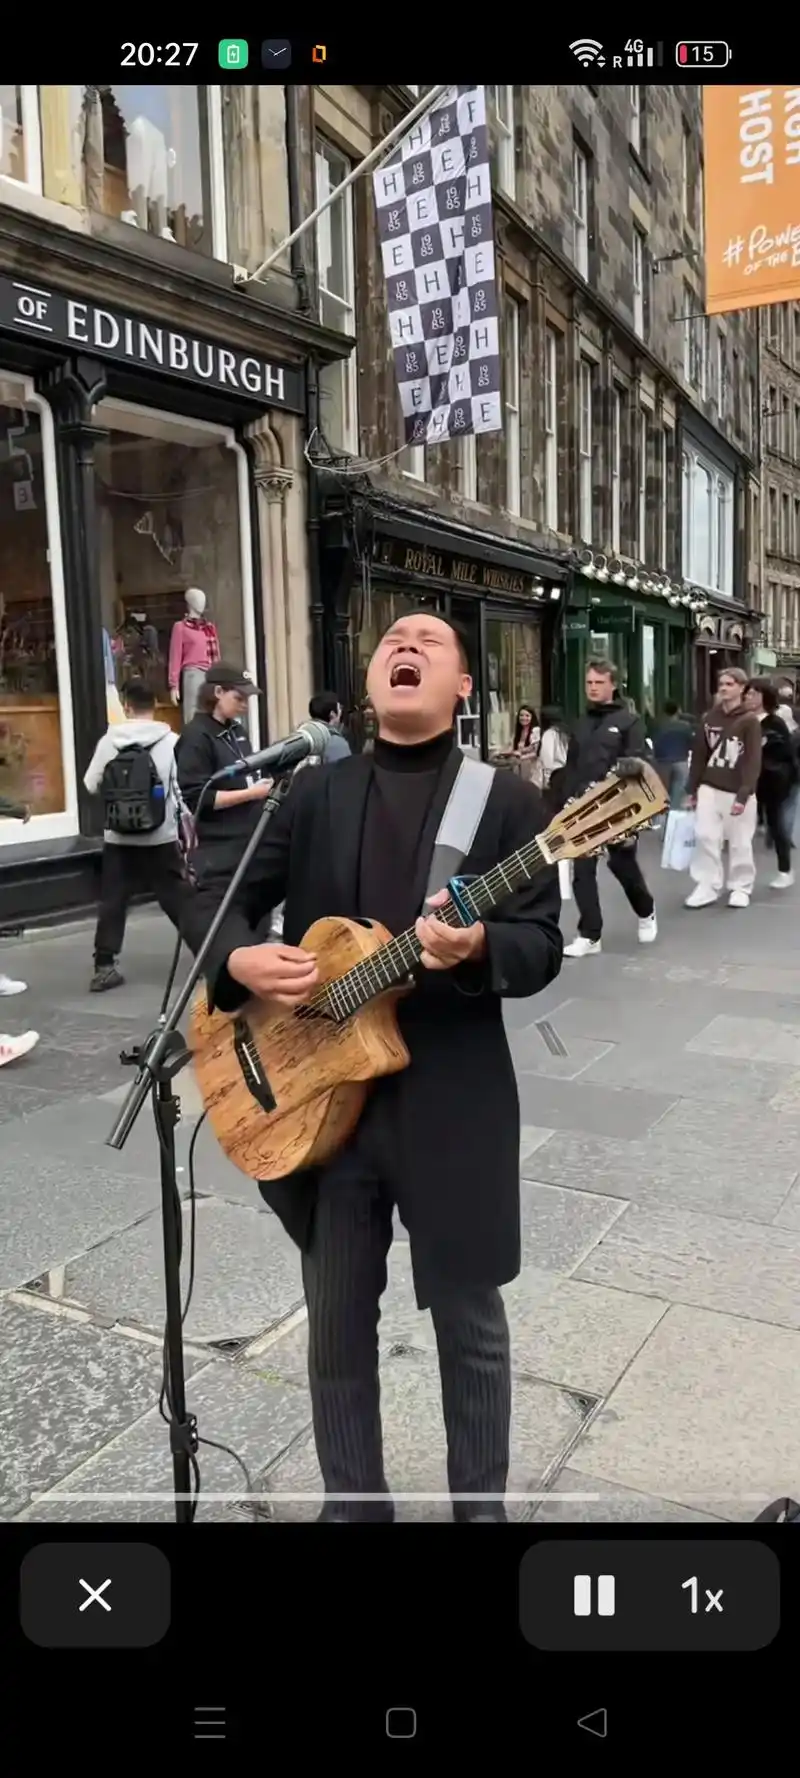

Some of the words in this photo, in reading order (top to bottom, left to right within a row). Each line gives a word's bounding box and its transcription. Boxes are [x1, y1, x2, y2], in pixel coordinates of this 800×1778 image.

[739, 88, 774, 185] HOST
[383, 172, 397, 196] H
[468, 175, 481, 199] H
[416, 198, 428, 220] E
[392, 245, 404, 267] E
[424, 271, 441, 293] H
[399, 316, 414, 337] H
[18, 296, 48, 320] OF
[67, 300, 286, 400] EDINBURGH
[475, 327, 488, 349] H
[436, 345, 449, 365] E
[411, 387, 422, 406] E
[480, 402, 491, 423] E
[404, 548, 445, 577] ROYAL
[451, 560, 477, 583] MILE
[483, 567, 525, 593] WHISKIES
